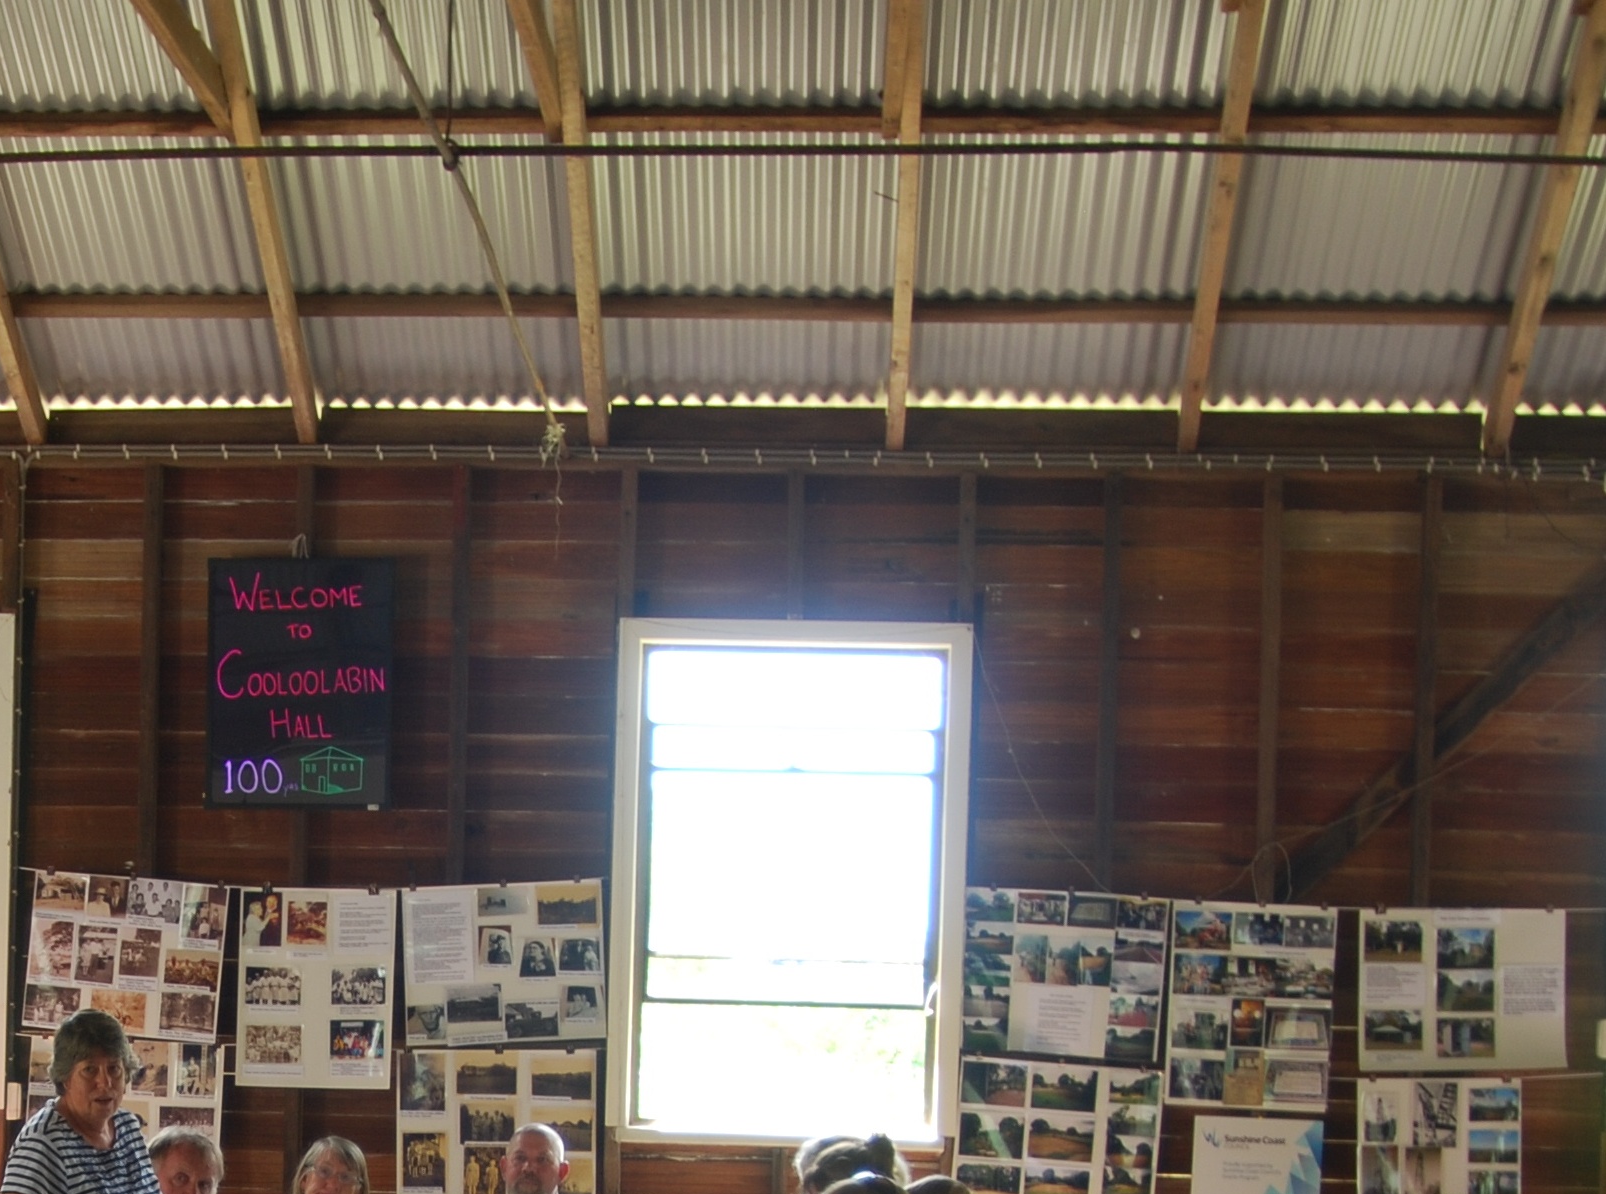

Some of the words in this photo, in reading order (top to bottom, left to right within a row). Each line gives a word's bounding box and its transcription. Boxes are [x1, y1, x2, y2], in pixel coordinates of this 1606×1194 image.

[228, 572, 363, 612] WELCOME
[286, 622, 313, 640] TO
[216, 648, 387, 700] COOLOOLABIN
[269, 708, 333, 739] HALL
[223, 757, 284, 794] 100
